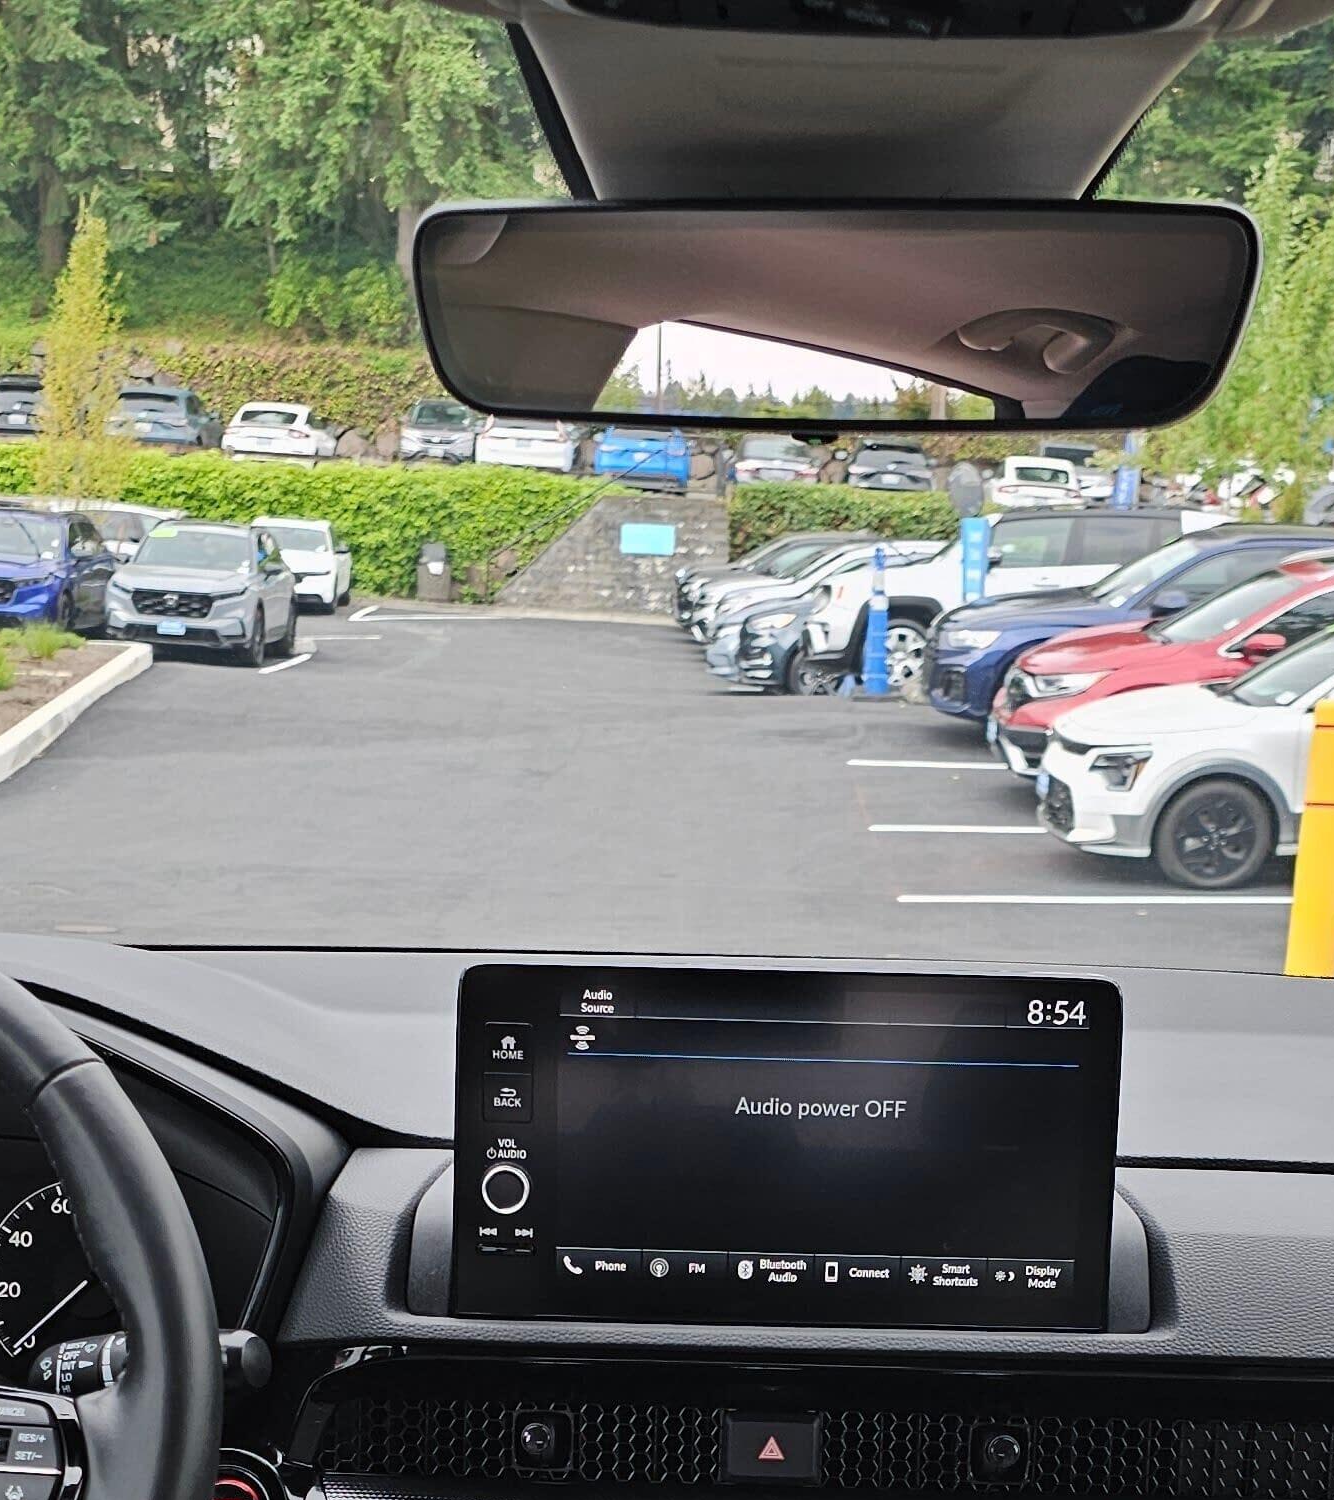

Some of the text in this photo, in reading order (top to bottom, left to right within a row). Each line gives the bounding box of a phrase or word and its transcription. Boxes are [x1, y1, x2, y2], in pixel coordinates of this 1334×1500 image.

[583, 989, 613, 1001] Audio
[581, 1003, 615, 1014] Source
[1026, 999, 1087, 1026] 8:54
[492, 1050, 524, 1060] HOME
[493, 1098, 522, 1108] BACK
[735, 1097, 907, 1119] Audio power OFF
[497, 1138, 517, 1149] VOL
[497, 1149, 527, 1160] AUDIO
[8, 1231, 33, 1248] 40
[595, 1260, 627, 1272] Phone
[688, 1262, 706, 1274] FM
[759, 1258, 807, 1270] Bluetooth
[941, 1263, 971, 1275] Smart
[768, 1272, 798, 1283] Audio
[848, 1267, 890, 1279] Connect
[1025, 1265, 1062, 1279] Display
[932, 1276, 979, 1287] Shortcuts
[1027, 1278, 1057, 1289] Mode
[62, 1350, 81, 1360] OFF
[61, 1373, 73, 1382] LO
